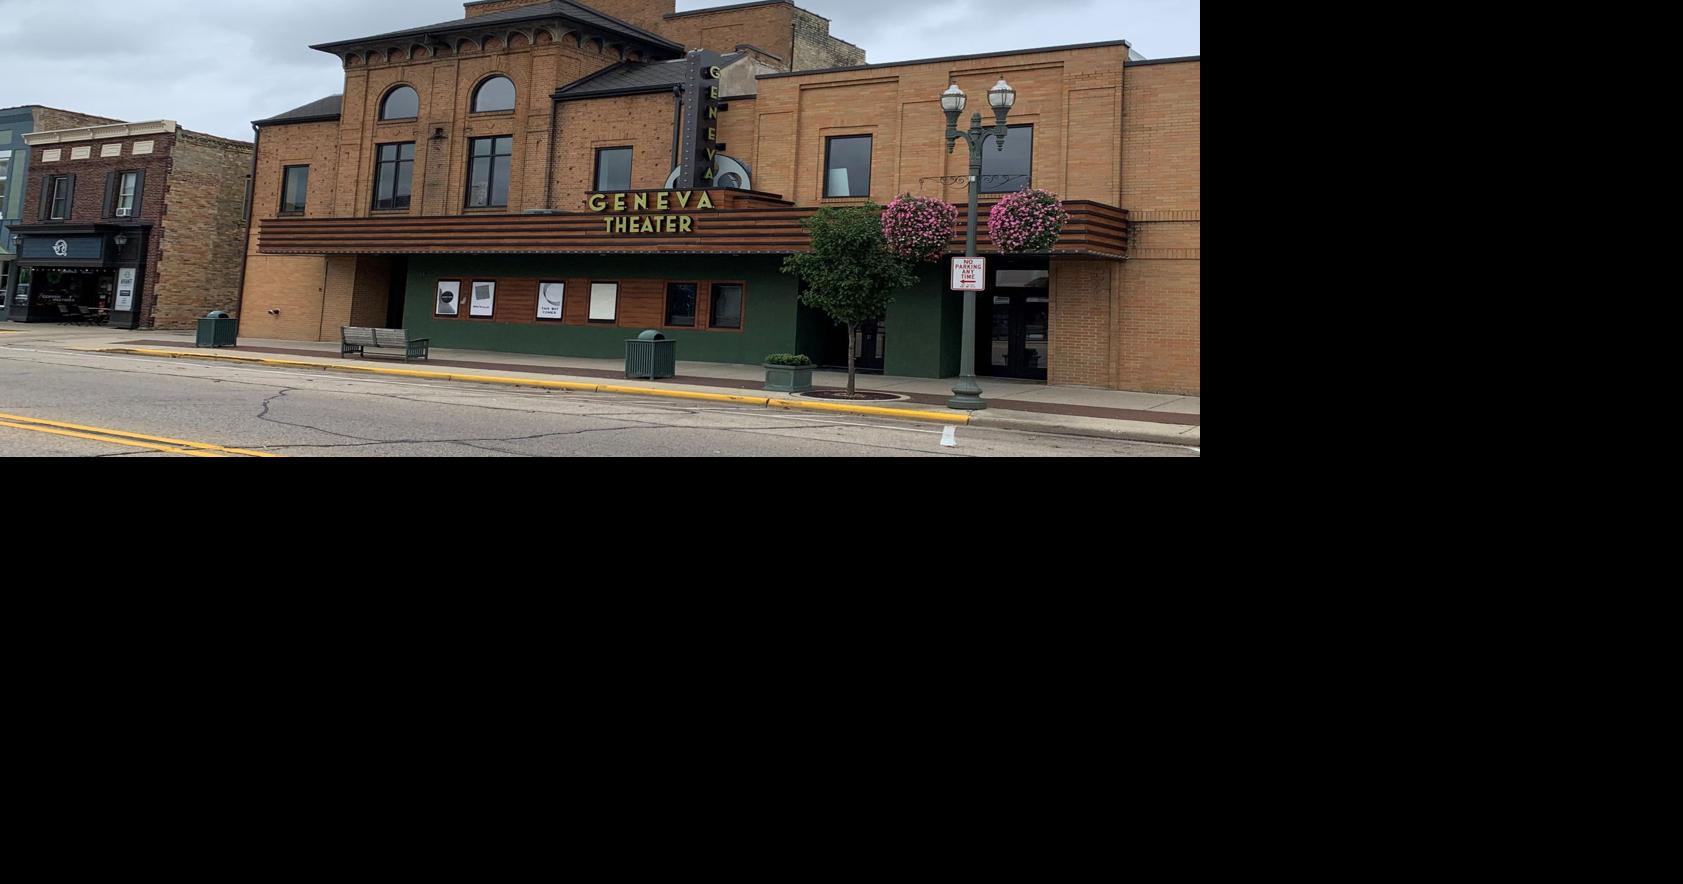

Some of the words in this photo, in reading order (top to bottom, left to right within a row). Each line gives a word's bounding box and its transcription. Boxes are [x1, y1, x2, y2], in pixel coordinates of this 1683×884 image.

[704, 65, 720, 179] GENEVA
[588, 191, 713, 211] GENEVA
[604, 215, 692, 232] THEATER
